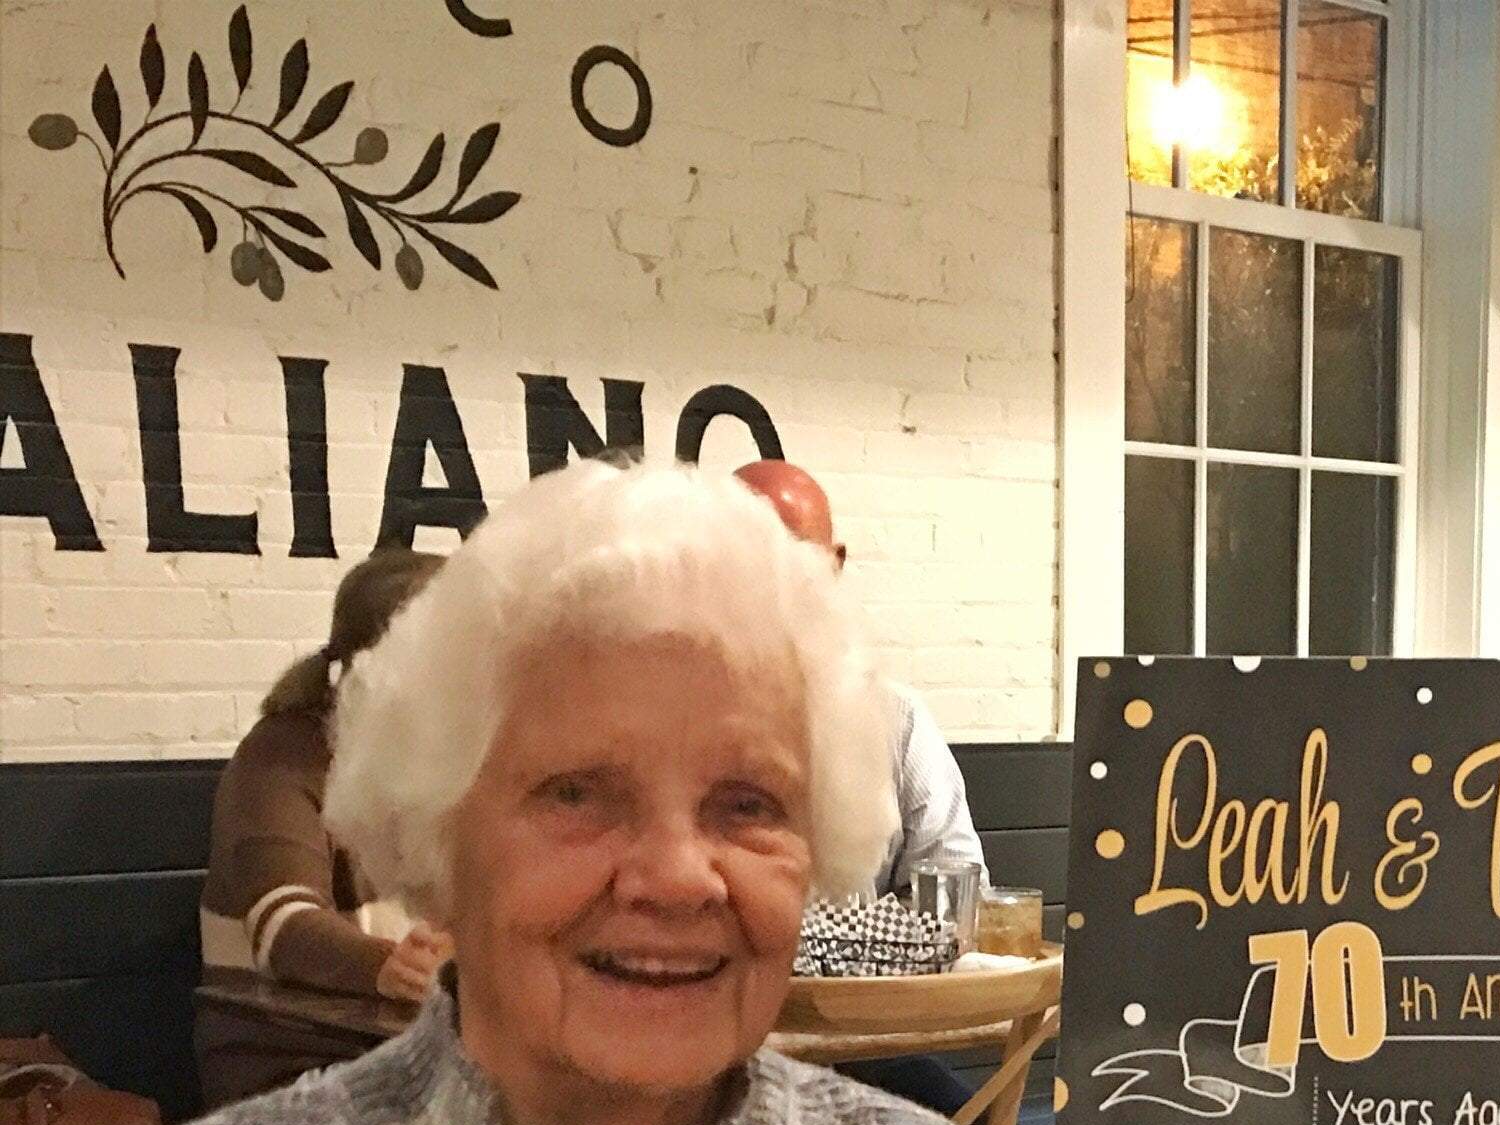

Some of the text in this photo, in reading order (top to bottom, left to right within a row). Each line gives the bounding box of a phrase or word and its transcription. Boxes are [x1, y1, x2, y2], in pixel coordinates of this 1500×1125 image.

[1133, 728, 1350, 930] Leah
[1374, 797, 1441, 912] &
[1248, 922, 1387, 1070] 70
[1399, 976, 1438, 1022] th
